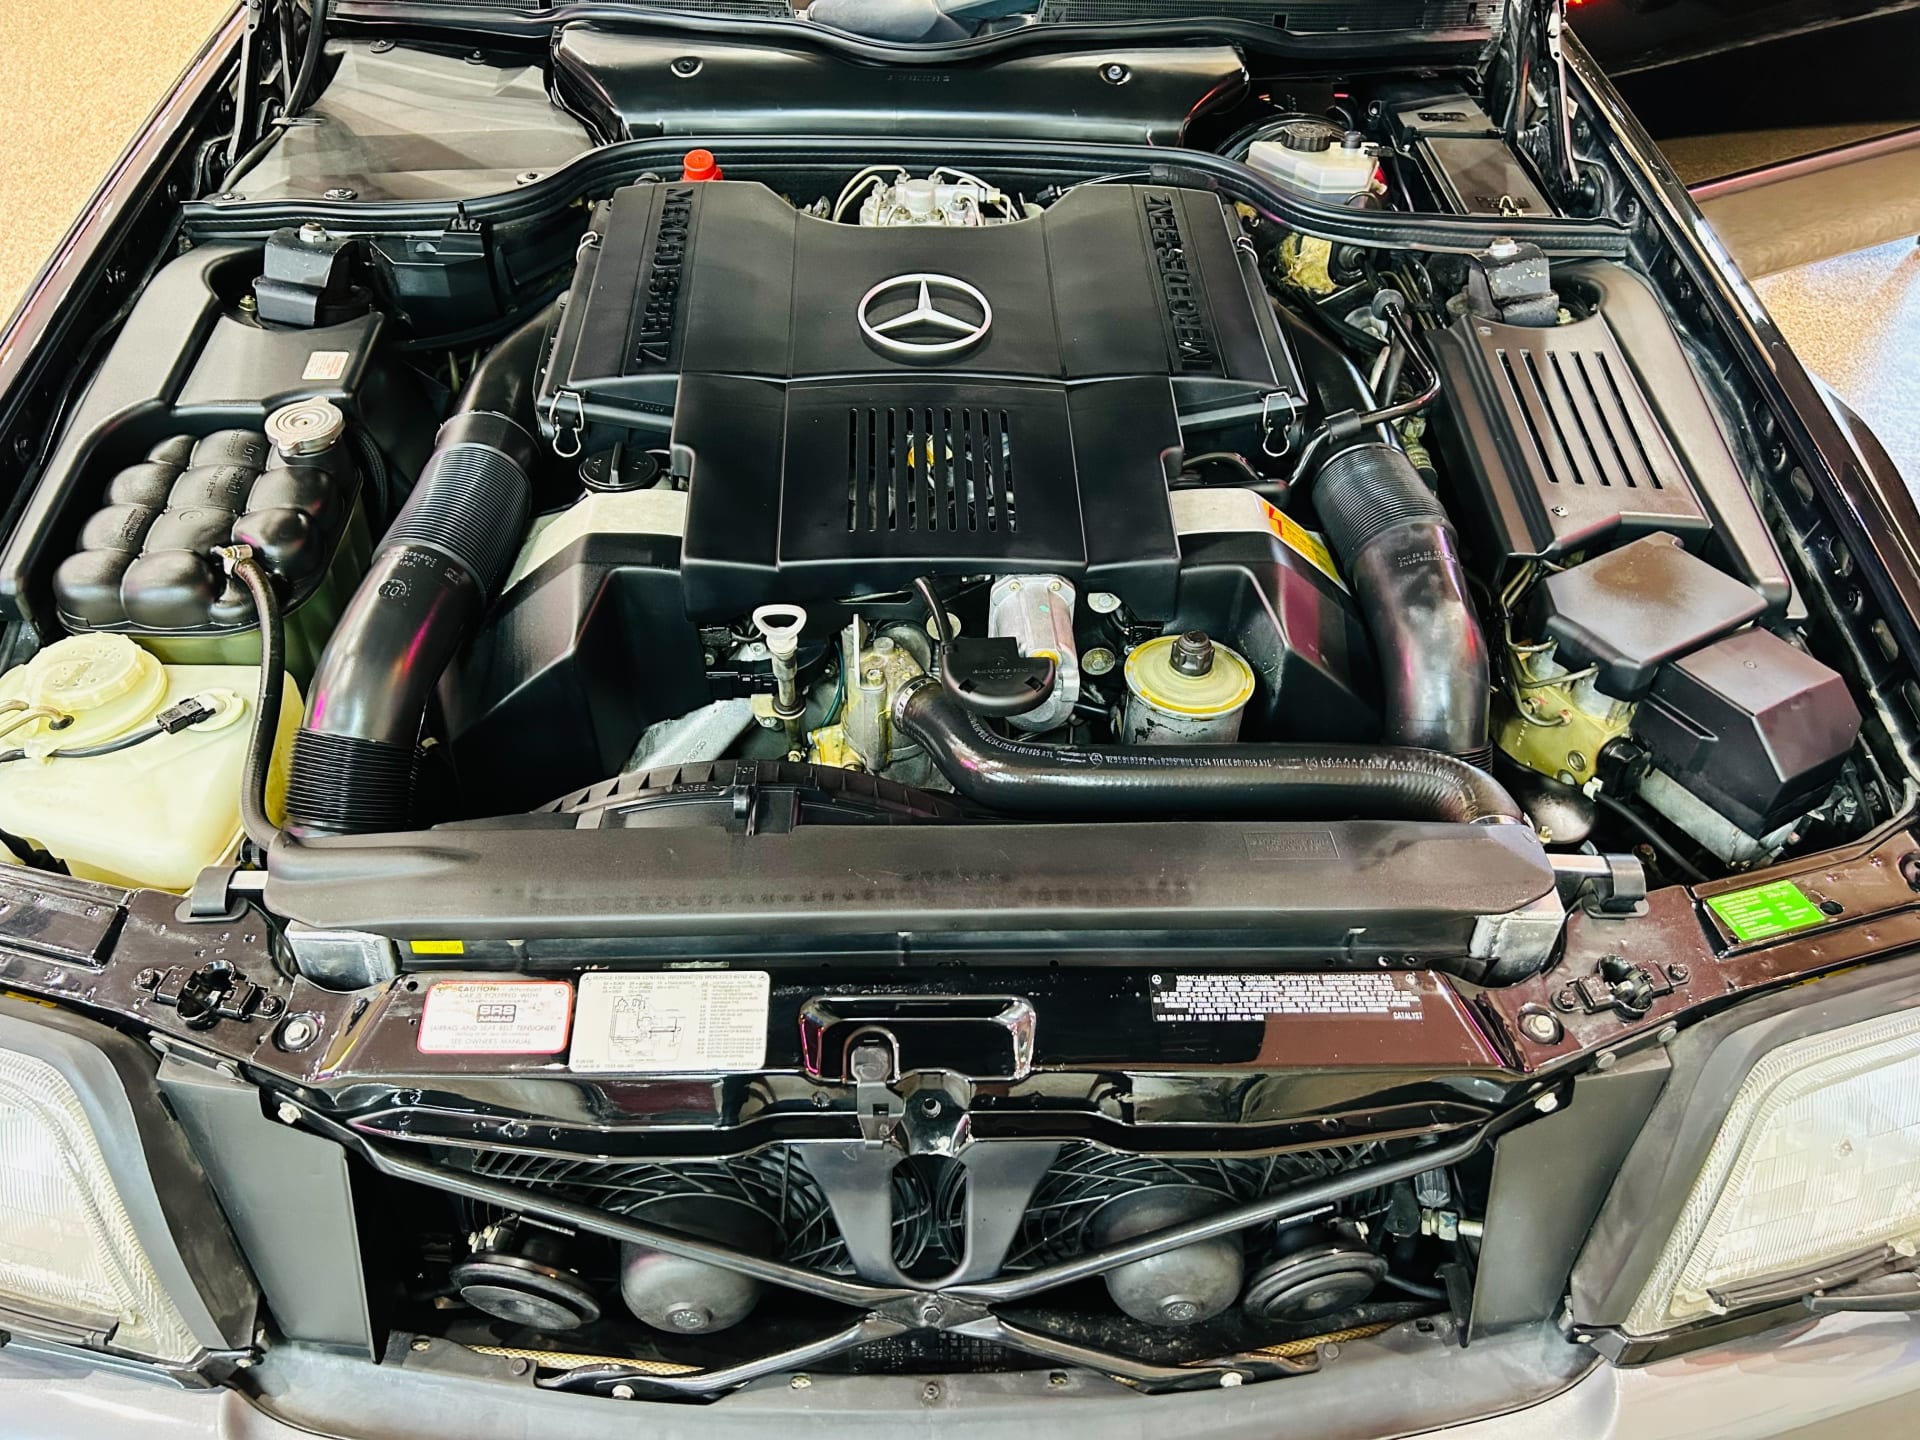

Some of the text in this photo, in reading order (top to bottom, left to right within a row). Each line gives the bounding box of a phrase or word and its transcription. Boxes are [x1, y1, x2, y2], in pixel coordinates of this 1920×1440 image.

[635, 188, 694, 363] MERCEDES-BENZ
[1143, 191, 1214, 370] MERCEDES-BENZ
[737, 766, 754, 774] TOP
[676, 784, 707, 793] CLOSE
[479, 1005, 515, 1015] SRS
[1393, 1011, 1423, 1020] CATALYST
